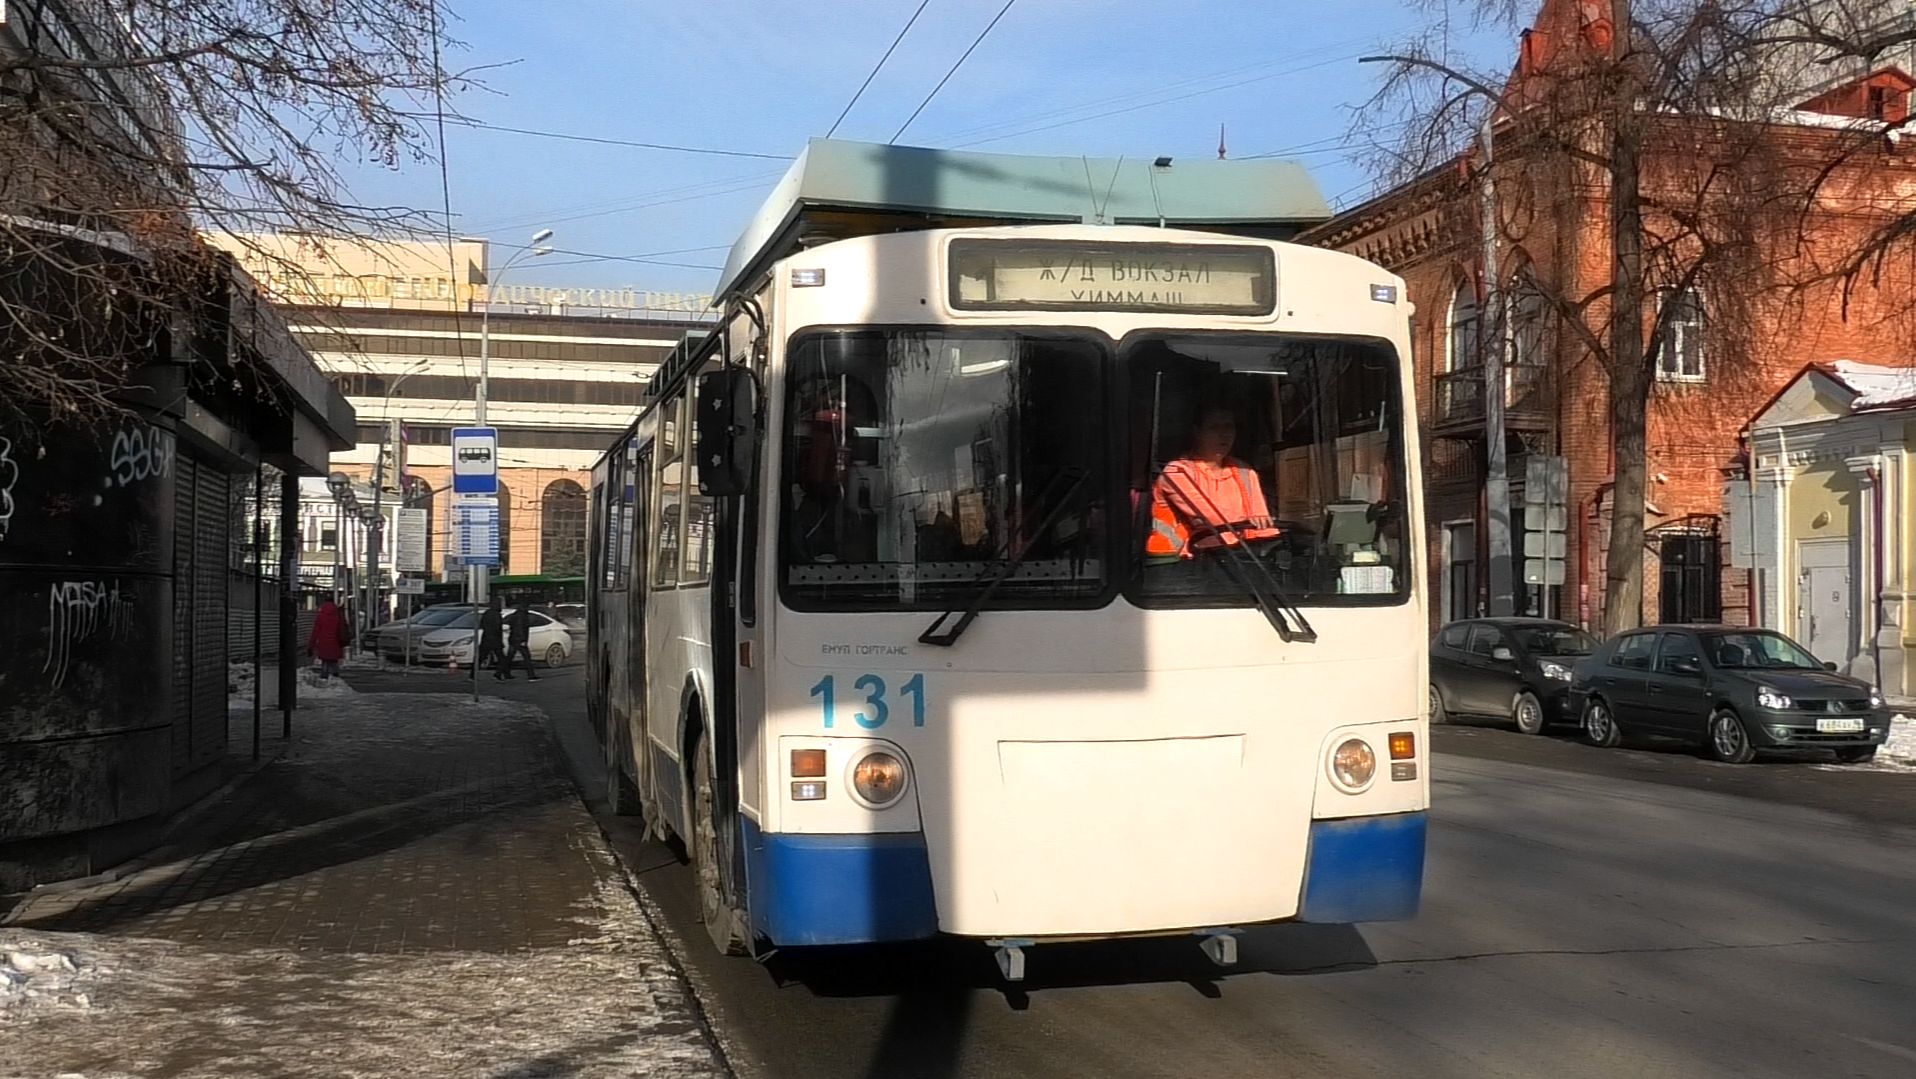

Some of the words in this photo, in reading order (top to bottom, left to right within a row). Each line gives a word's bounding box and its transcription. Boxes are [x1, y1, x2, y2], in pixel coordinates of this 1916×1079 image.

[1038, 257, 1096, 283] Ж/Д
[1111, 258, 1211, 284] ВОКЗАЛ
[855, 644, 908, 656] ГОРТРАНС
[810, 673, 925, 729] 131
